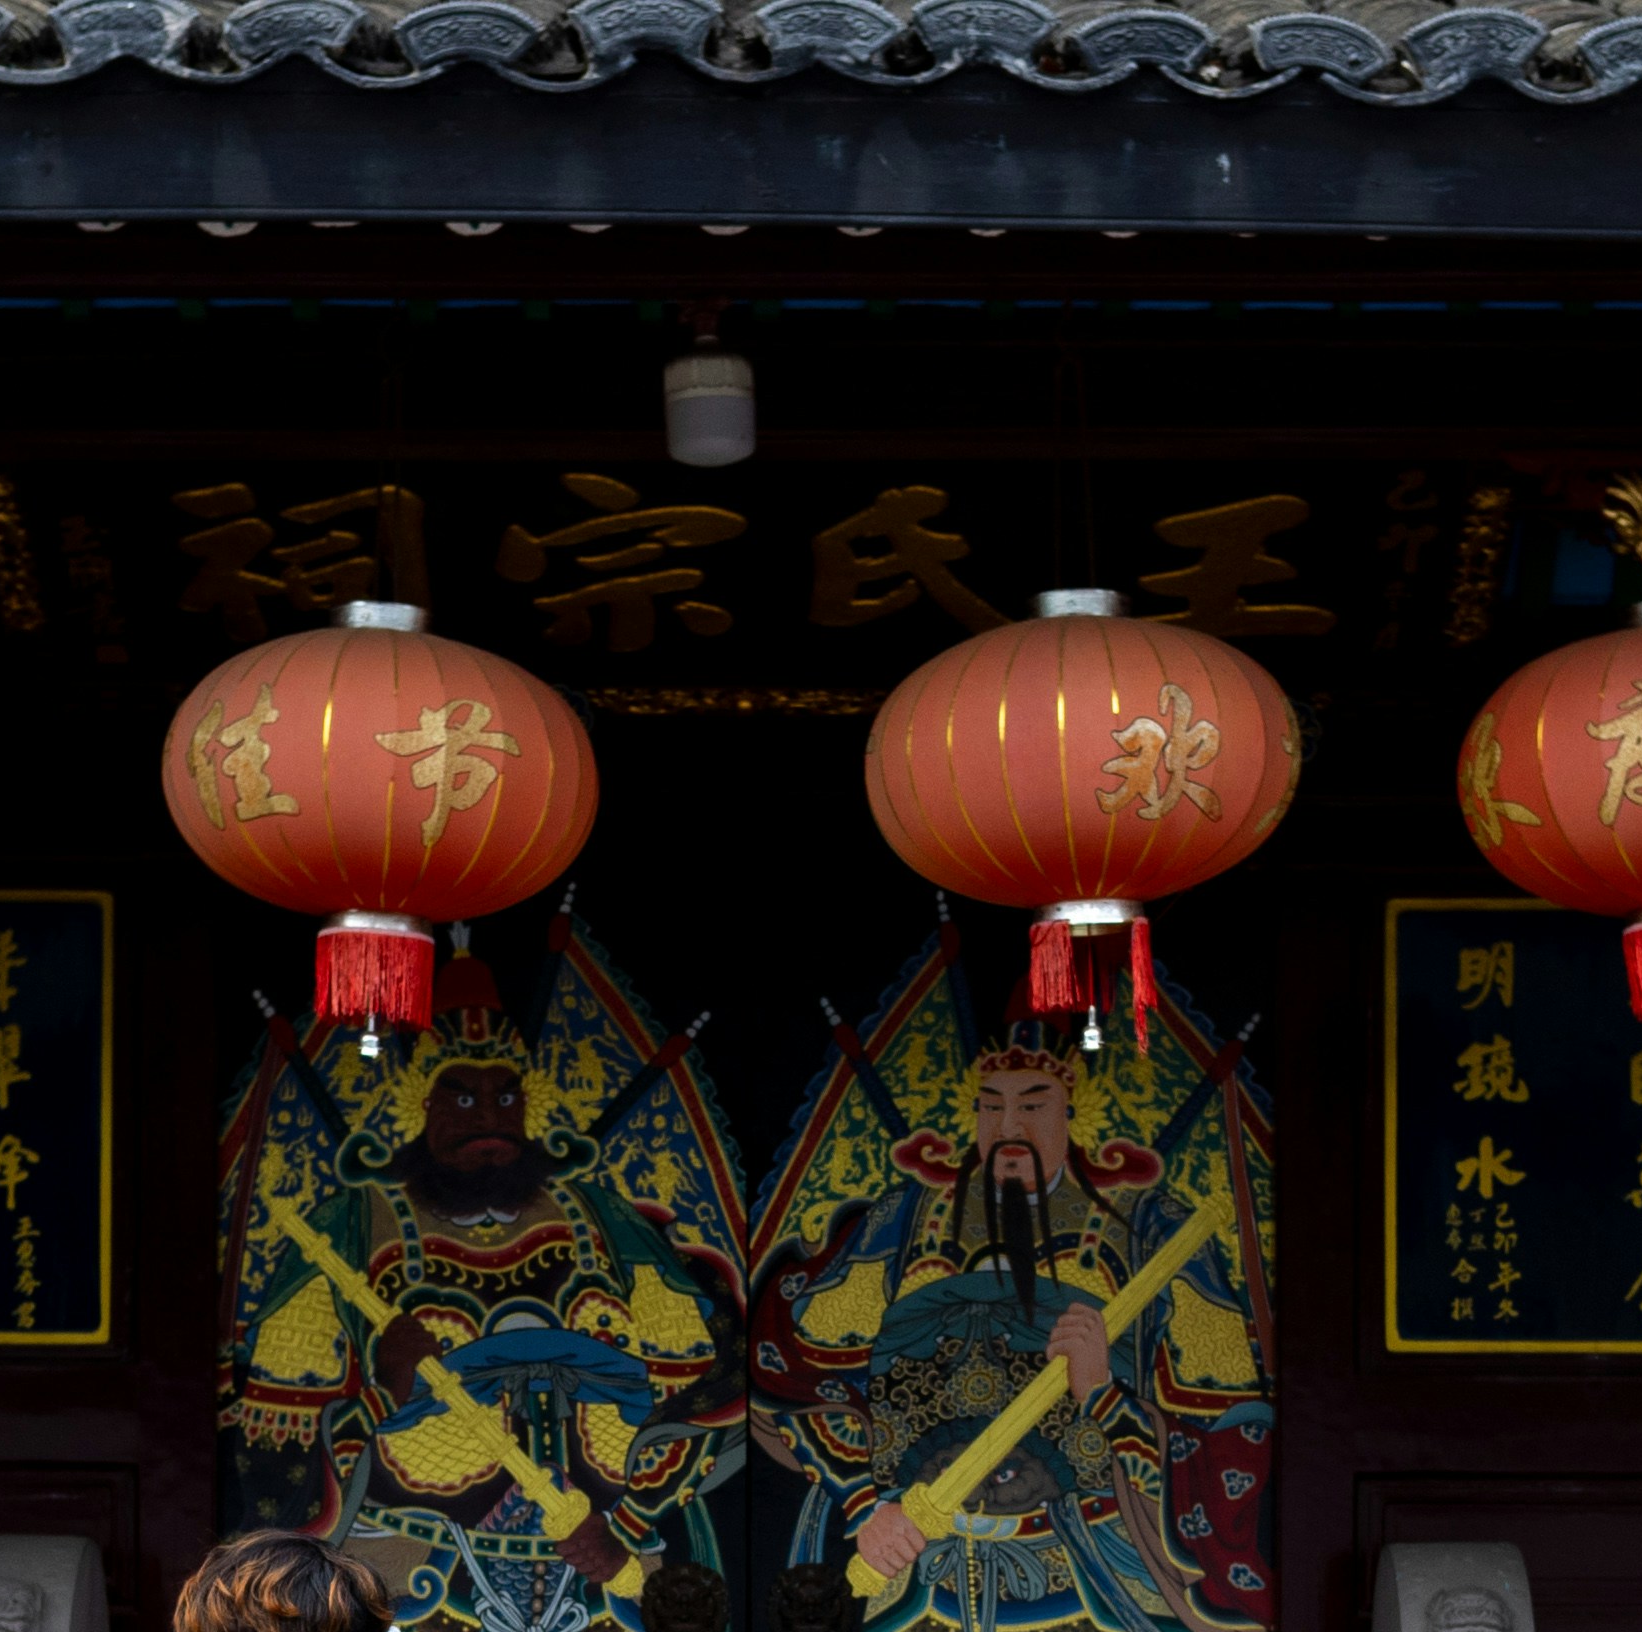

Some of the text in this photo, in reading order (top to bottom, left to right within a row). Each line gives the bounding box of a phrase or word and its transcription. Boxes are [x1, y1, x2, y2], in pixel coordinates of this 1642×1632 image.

[170, 470, 1338, 653] 王氏宗祠
[185, 681, 523, 848] 佳节
[1094, 682, 1223, 821] 欢
